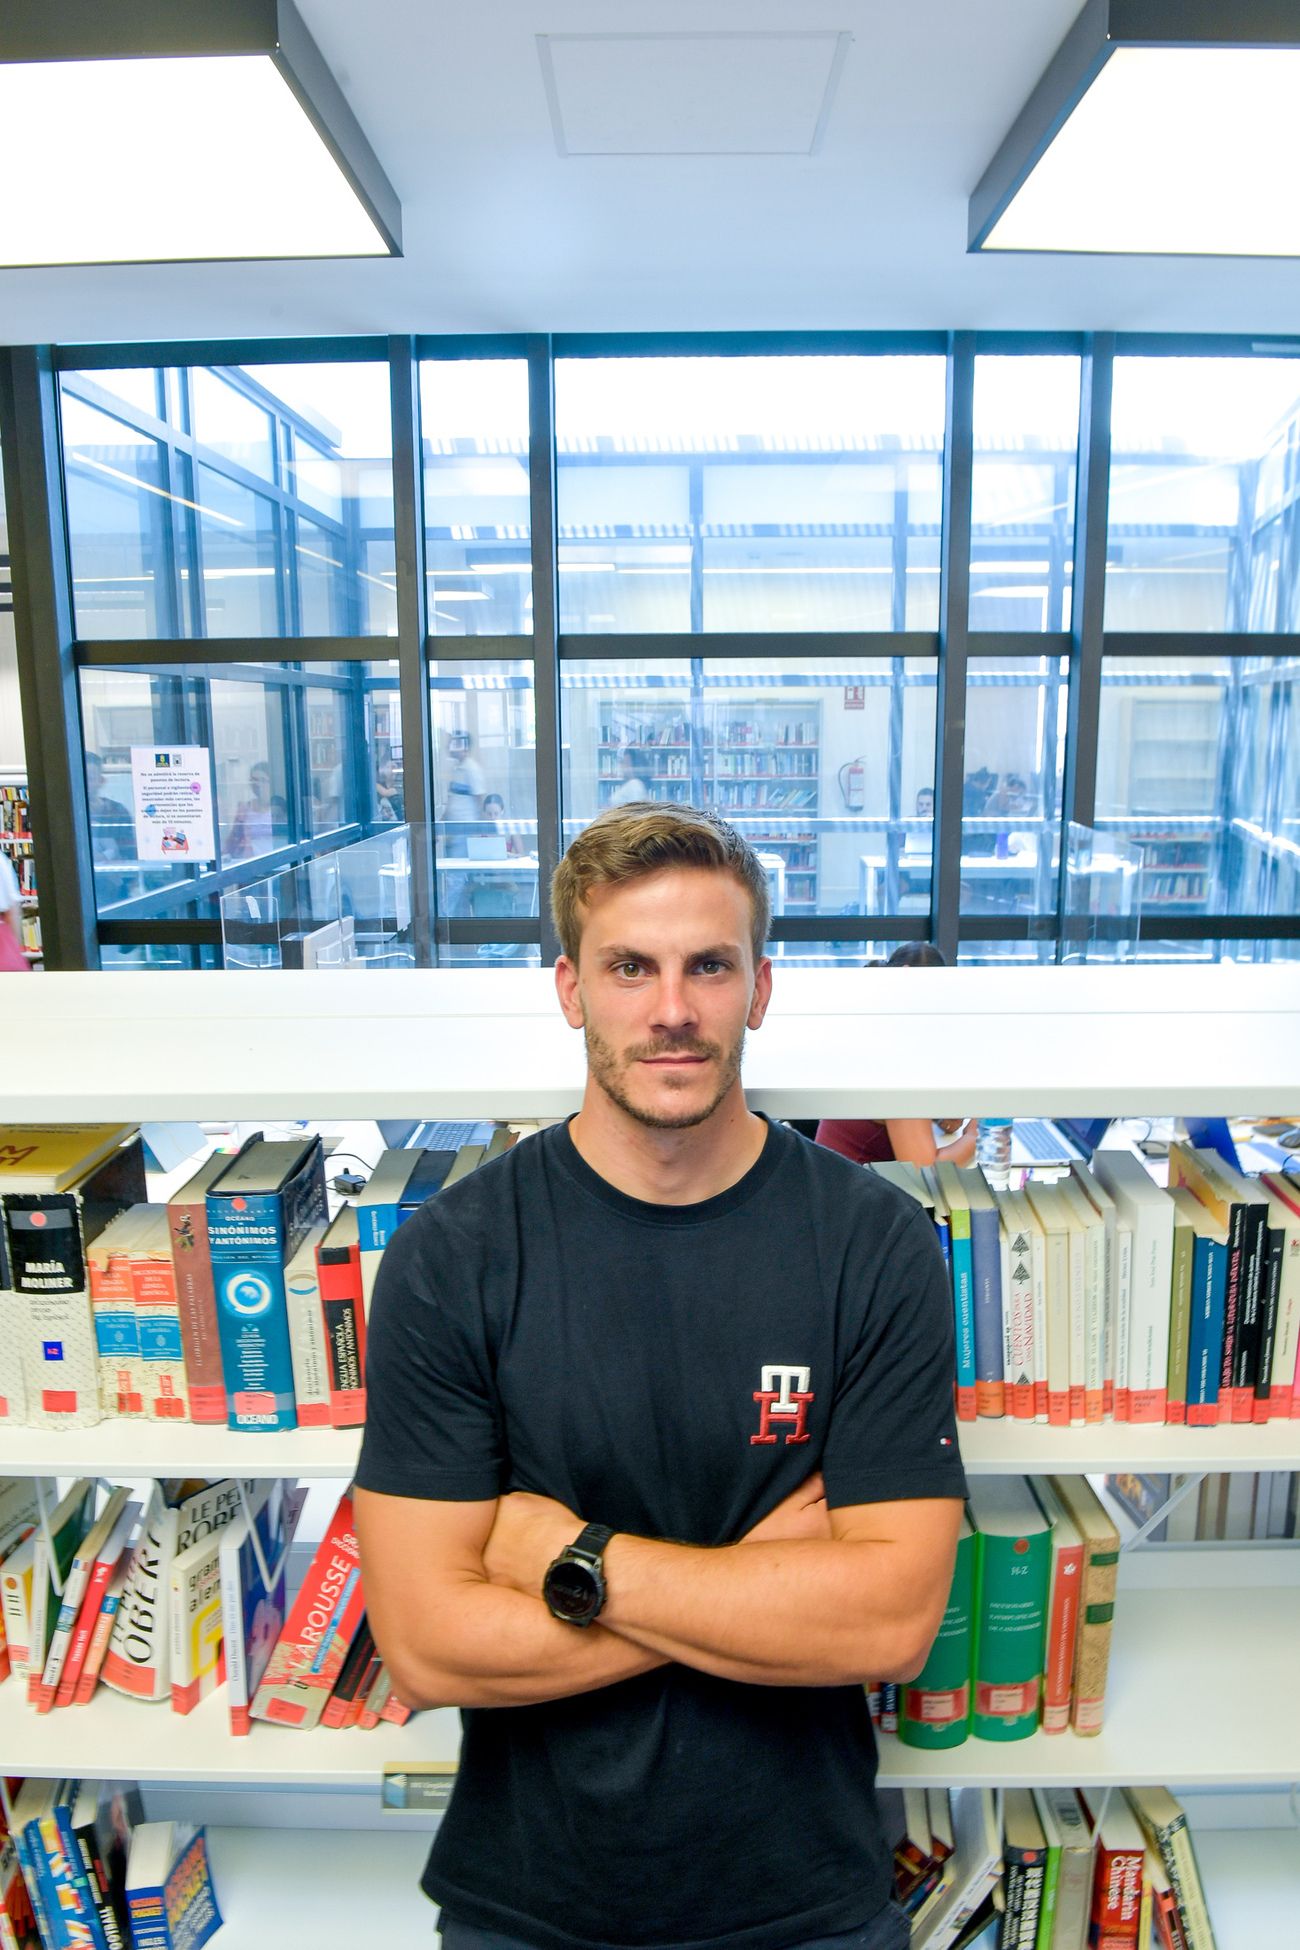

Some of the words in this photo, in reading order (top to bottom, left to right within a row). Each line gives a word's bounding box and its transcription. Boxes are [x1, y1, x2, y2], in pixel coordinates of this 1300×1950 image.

[207, 1225, 277, 1235] SINÓNIMOS
[21, 1277, 74, 1289] MOLINER
[25, 1260, 66, 1274] MARÍA
[962, 1328, 972, 1369] Mujeres
[339, 1364, 349, 1391] ENGUA
[175, 1501, 242, 1556] ROBE
[123, 1530, 161, 1663] OBER
[289, 1555, 351, 1671] LAROUSSE
[1107, 1855, 1127, 1910] Chinese
[1121, 1855, 1142, 1921] Mandarin
[99, 1905, 124, 1950] OOTBALL
